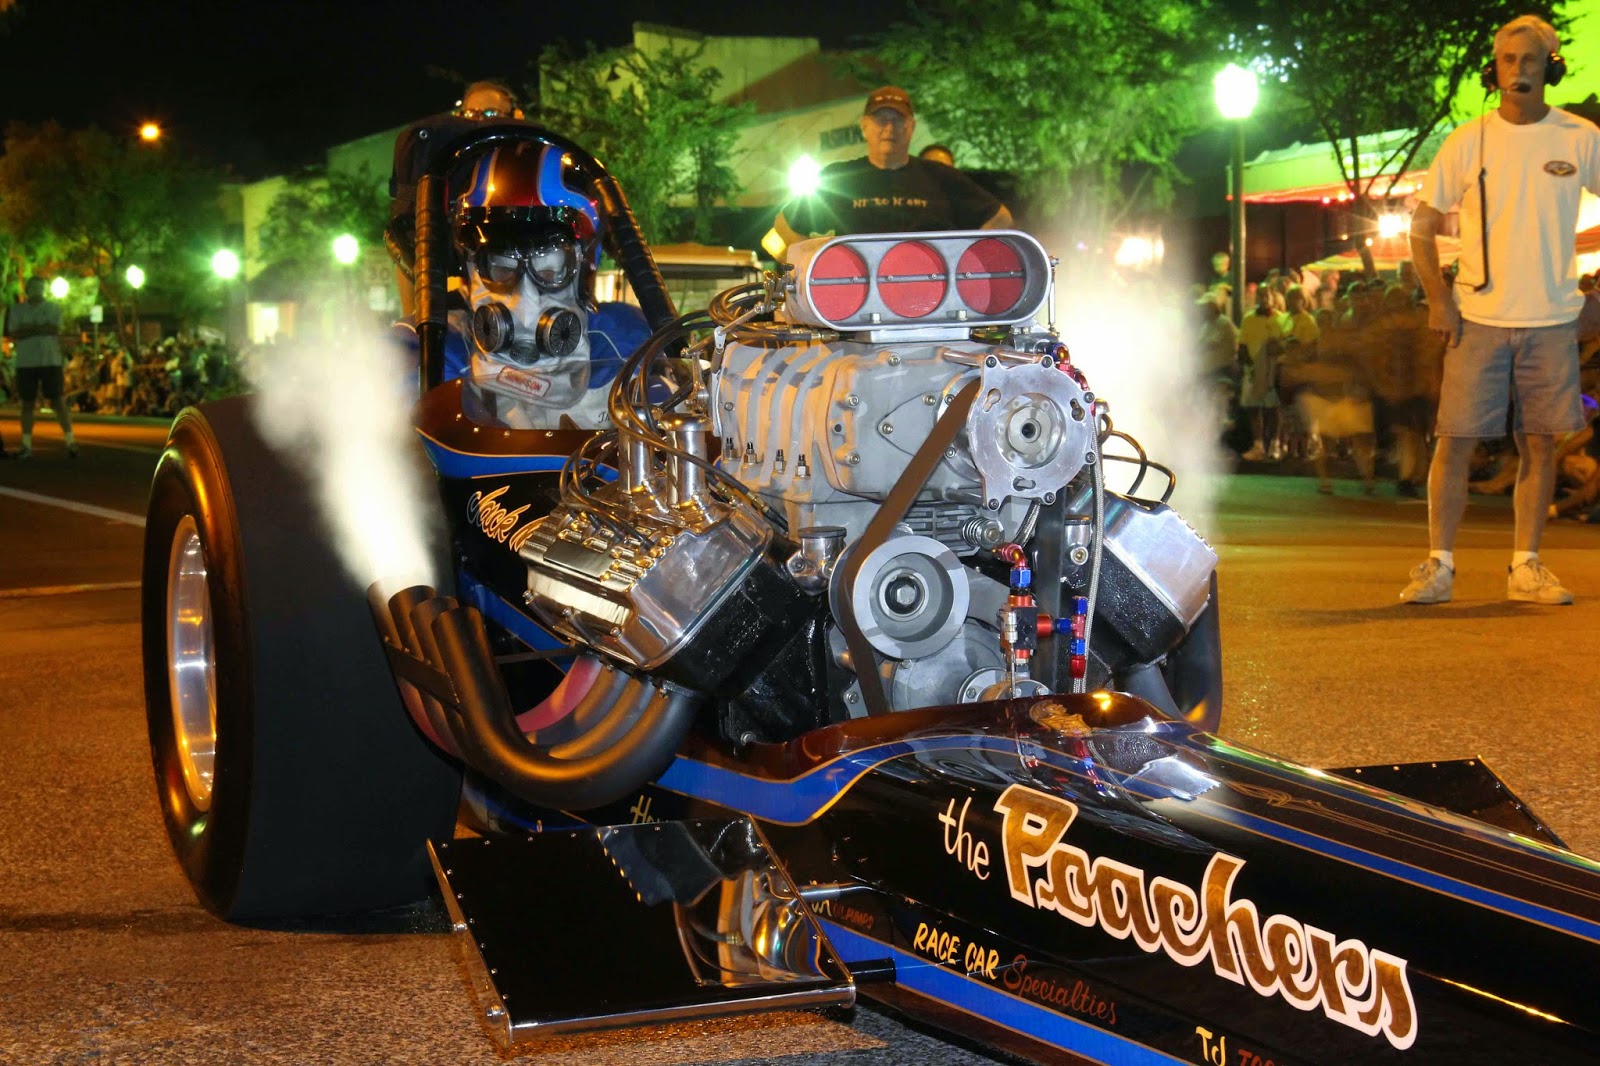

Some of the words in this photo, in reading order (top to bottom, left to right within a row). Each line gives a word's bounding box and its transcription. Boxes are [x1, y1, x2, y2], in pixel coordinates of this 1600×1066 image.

[912, 922, 958, 966] RACE
[964, 942, 1000, 981] CAR
[1003, 954, 1118, 1026] Specialties
[937, 797, 991, 881] the
[993, 783, 1419, 1052] Poachers
